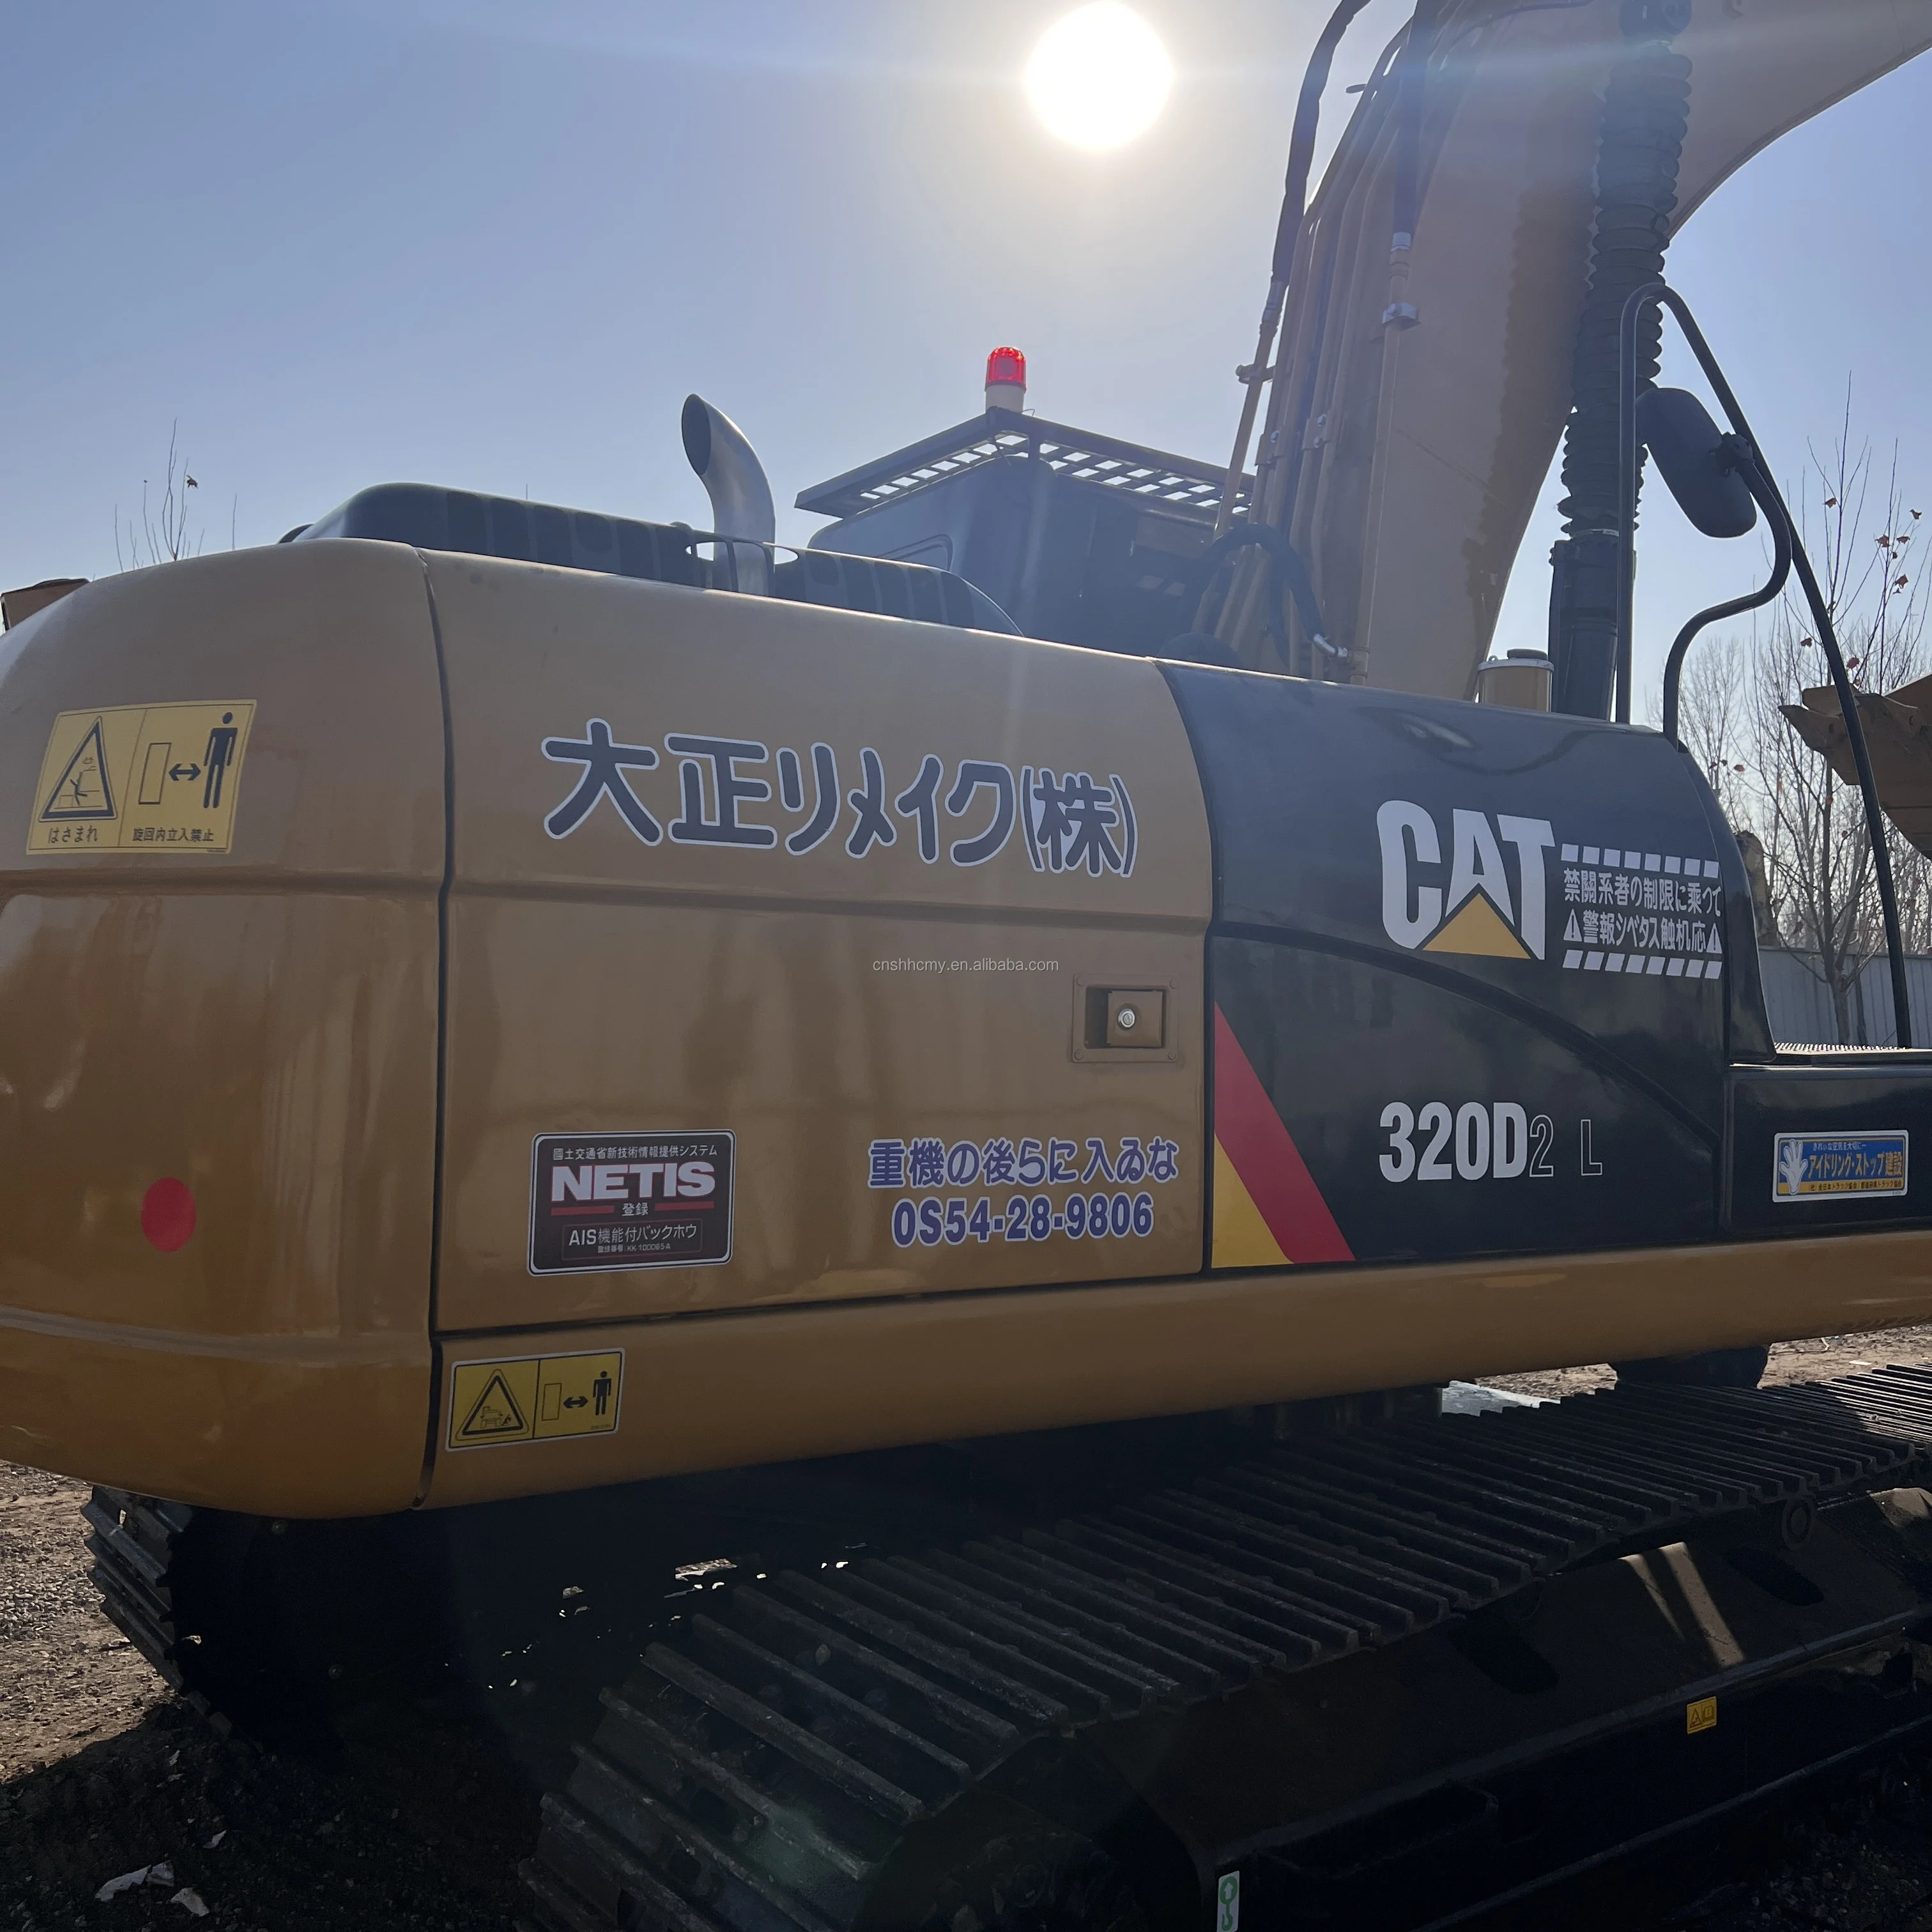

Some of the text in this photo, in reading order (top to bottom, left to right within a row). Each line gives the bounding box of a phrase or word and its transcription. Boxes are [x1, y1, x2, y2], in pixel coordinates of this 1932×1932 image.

[48, 825, 98, 844] はさまれ
[1376, 800, 1556, 960] CAT
[1581, 1119, 1602, 1176] L
[551, 1162, 716, 1201] NETIS
[622, 1202, 648, 1216] 登録
[569, 1223, 697, 1246] AIS機能付バックホウ
